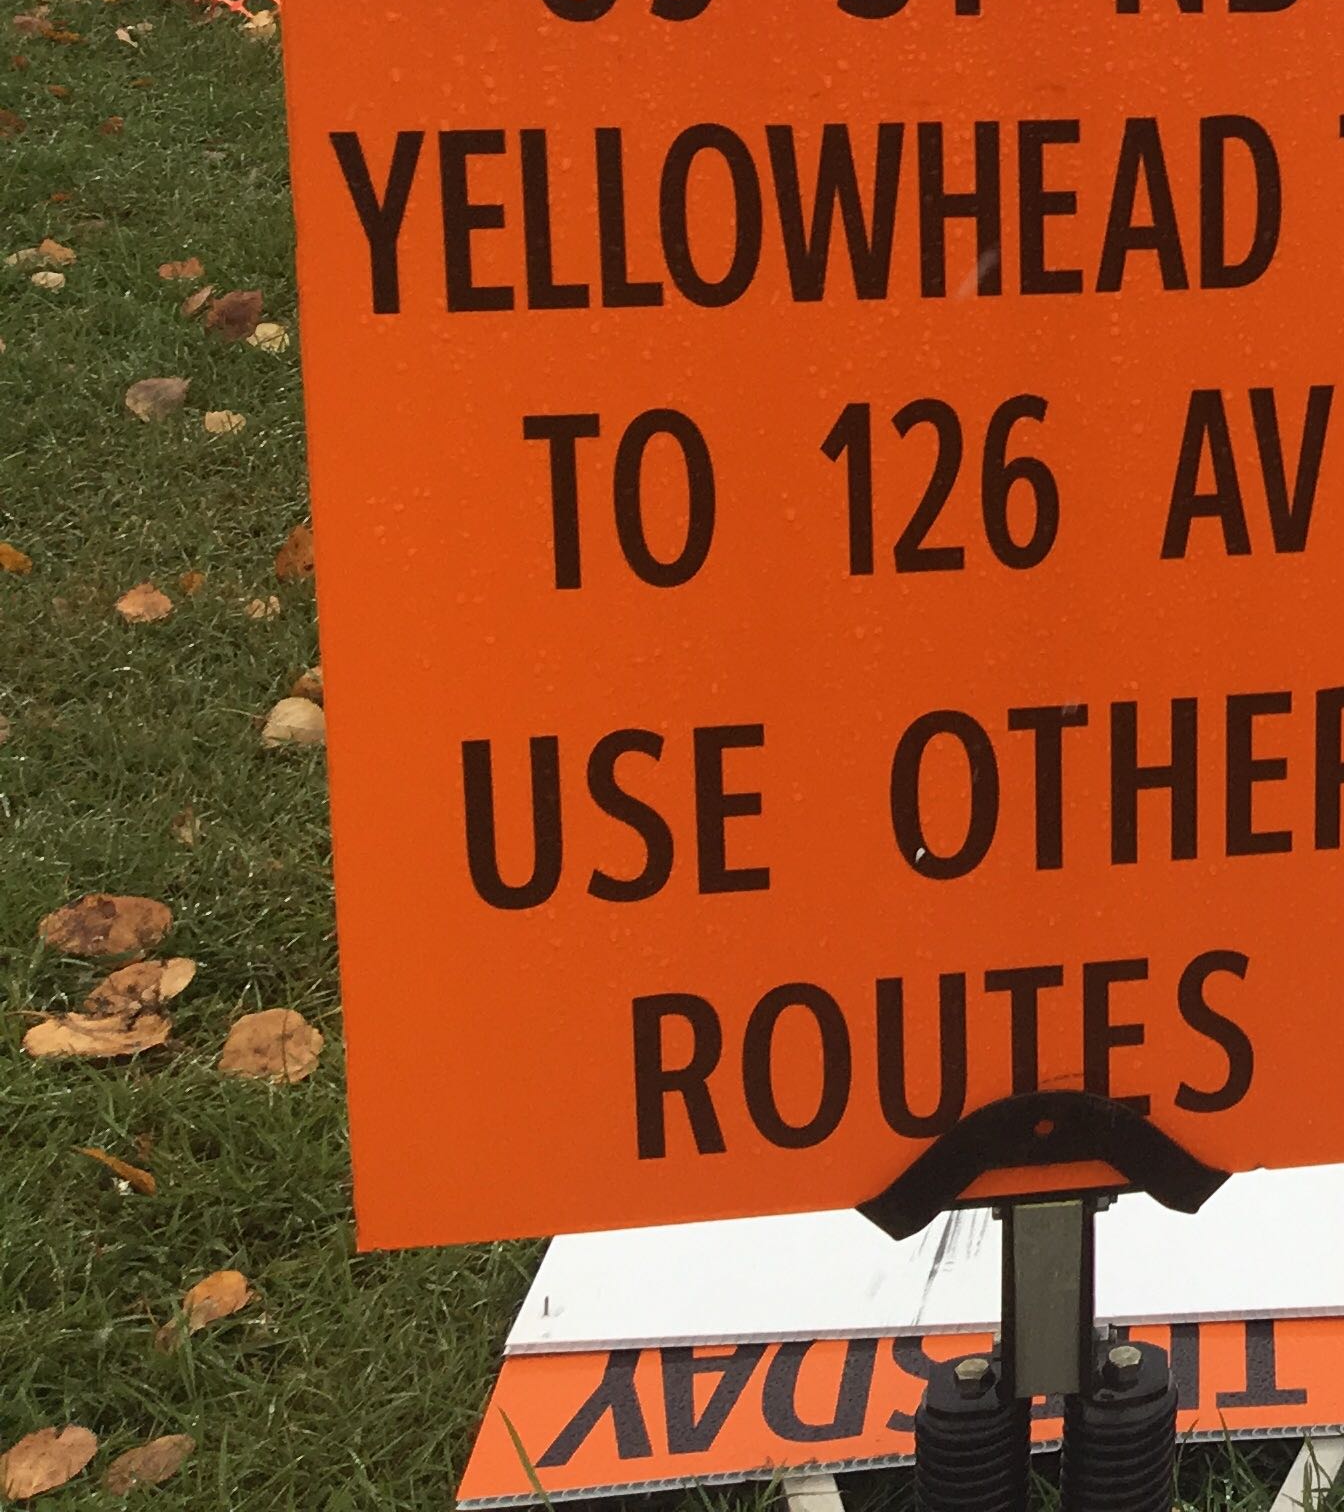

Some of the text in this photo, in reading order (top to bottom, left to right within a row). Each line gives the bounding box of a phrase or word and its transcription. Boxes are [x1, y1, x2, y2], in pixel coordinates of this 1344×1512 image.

[330, 115, 1281, 314] YELLOWHEAD
[524, 386, 1333, 589] TO 126 AV
[462, 724, 769, 909] USE
[632, 950, 1253, 1159] ROUTES
